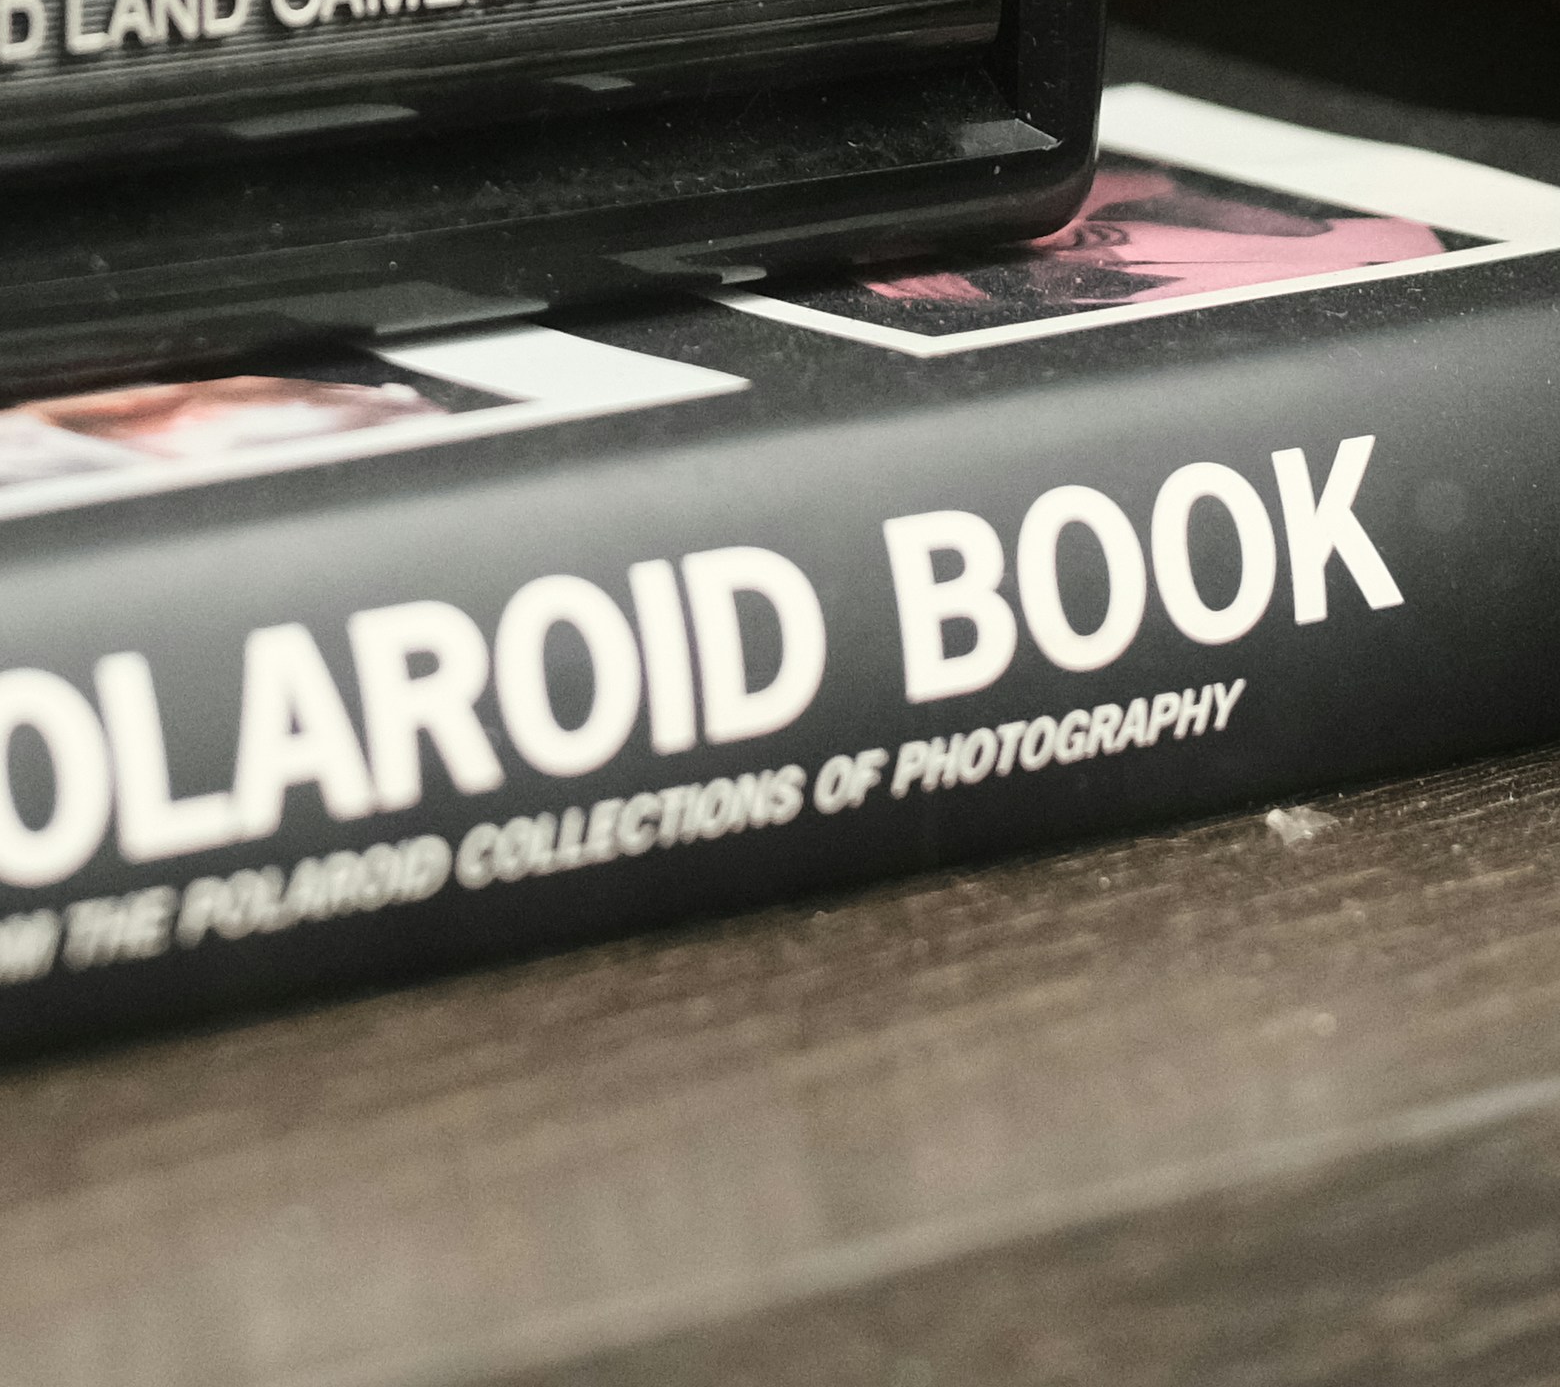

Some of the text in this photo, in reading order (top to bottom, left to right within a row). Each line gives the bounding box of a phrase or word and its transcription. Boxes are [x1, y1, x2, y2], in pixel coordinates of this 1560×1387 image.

[883, 434, 1405, 704] BOOK
[63, 885, 177, 970] THE
[176, 834, 453, 949] POLAROID
[455, 764, 806, 890] COLLECTIONS
[813, 747, 889, 815] OF
[890, 677, 1247, 800] PHOTOGRAPHY
